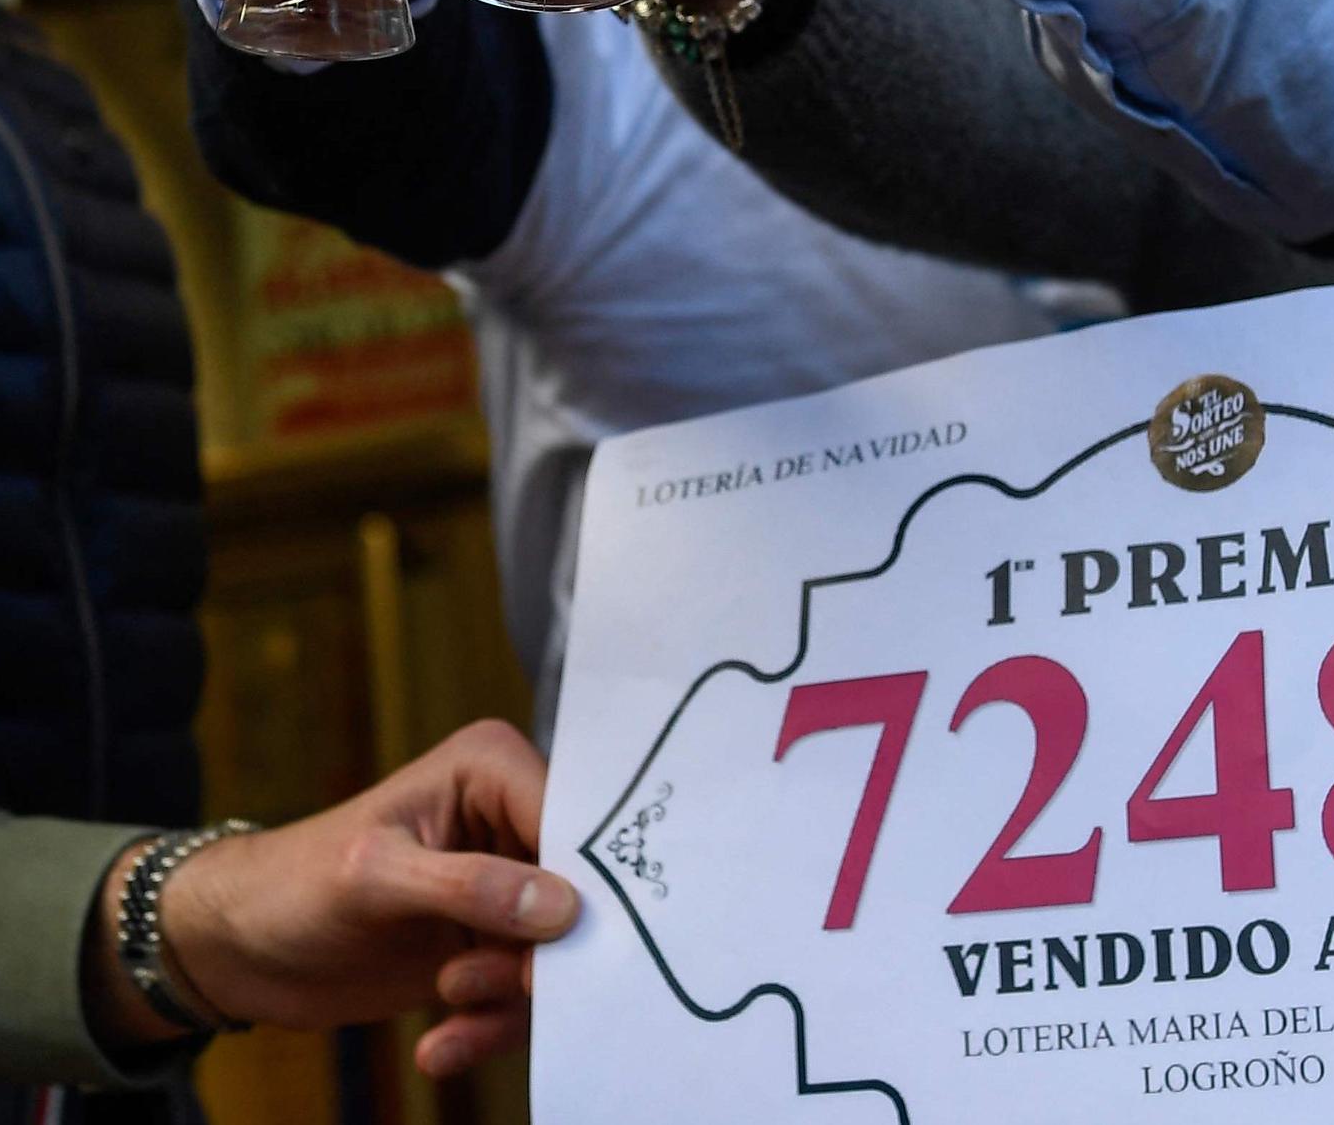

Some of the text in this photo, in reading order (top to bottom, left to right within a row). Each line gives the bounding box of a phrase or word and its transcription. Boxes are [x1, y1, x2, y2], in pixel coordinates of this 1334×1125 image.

[1172, 391, 1244, 442] SORTEO
[636, 421, 968, 507] LOTERÍA DE NAVIDAD
[1176, 444, 1207, 472] NOS
[1208, 423, 1244, 457] UNE
[943, 919, 1291, 997] VENDIDO
[962, 1020, 1115, 1057] LOTERIA
[1128, 1010, 1250, 1045] MARIA
[1263, 1005, 1334, 1036] DEL
[1142, 1050, 1326, 1095] LOGROÑO
